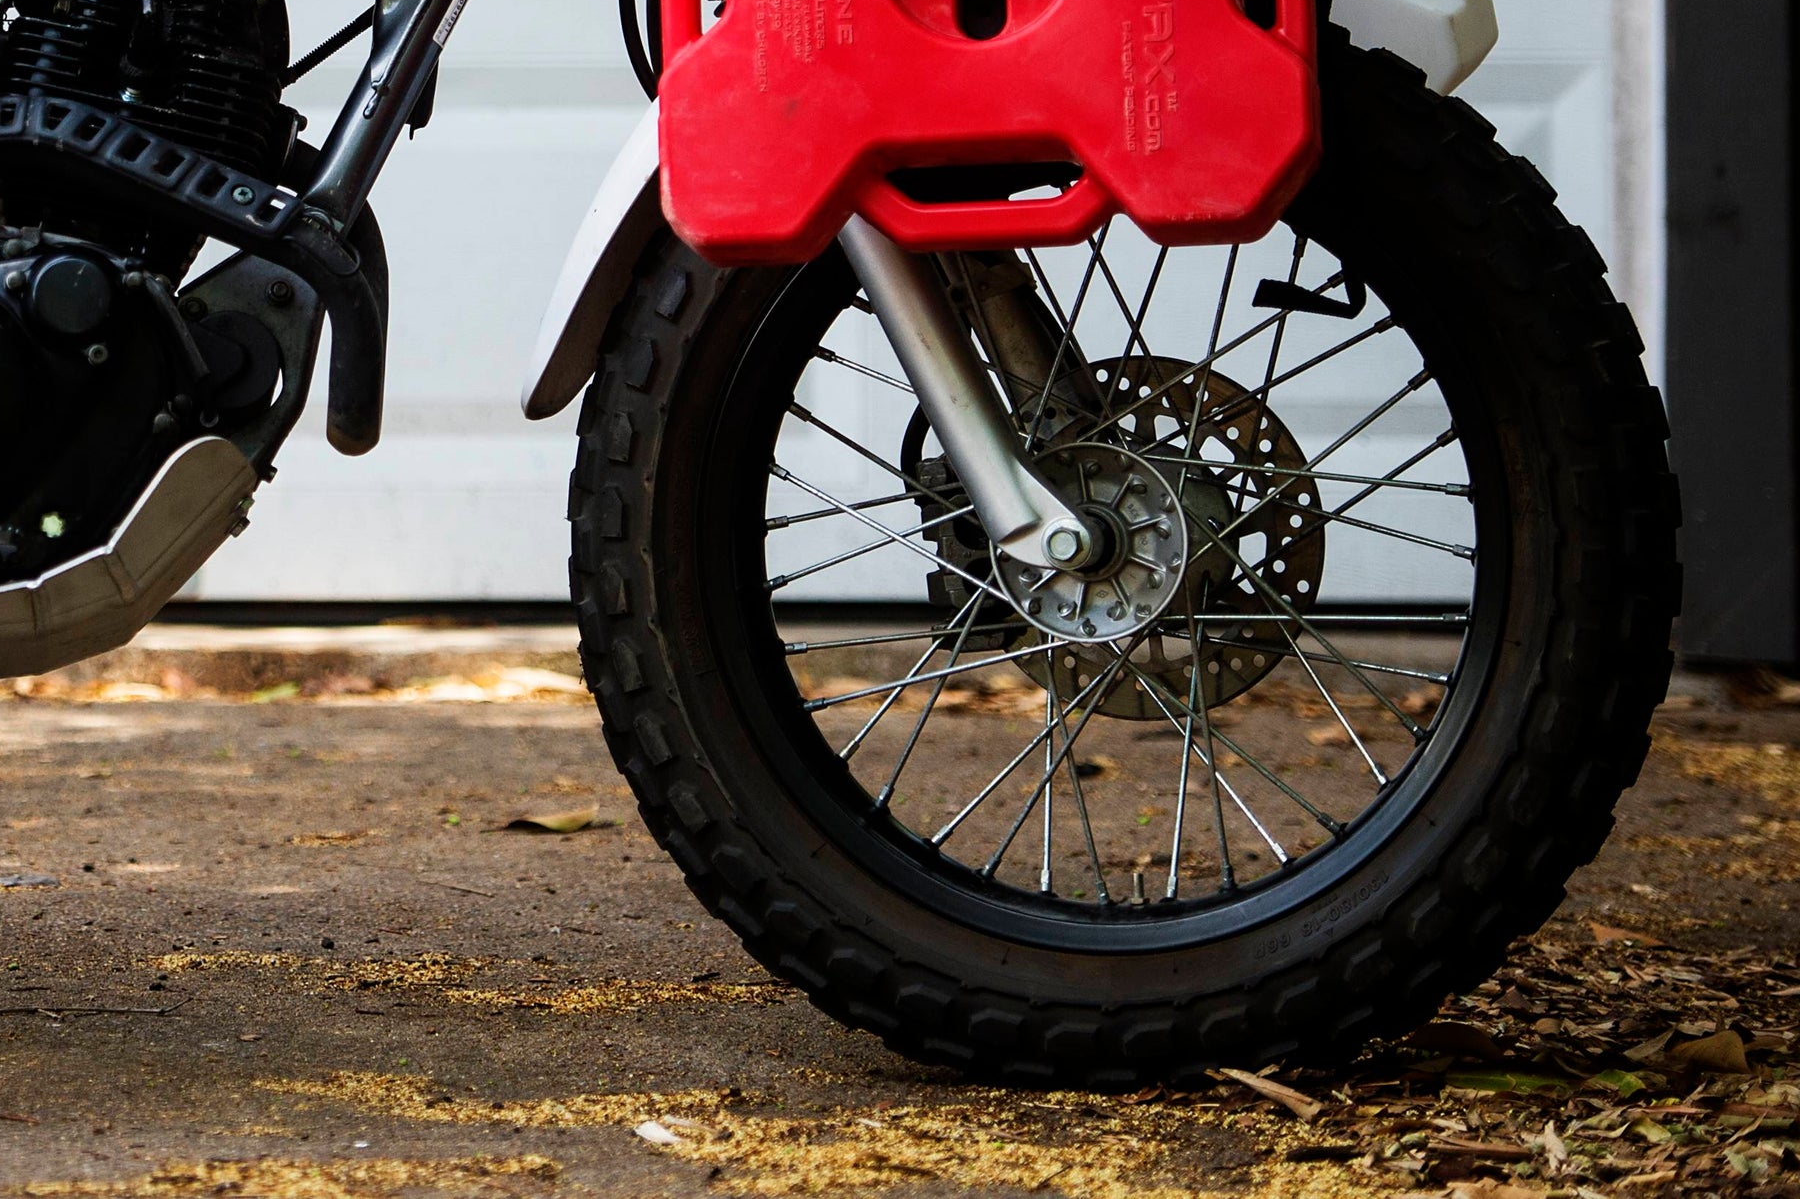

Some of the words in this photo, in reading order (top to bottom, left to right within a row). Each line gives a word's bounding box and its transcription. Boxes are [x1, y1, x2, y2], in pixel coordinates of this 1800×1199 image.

[756, 11, 765, 26] BY
[756, 30, 768, 92] CHILDREN
[1122, 20, 1134, 82] PATENT
[1124, 86, 1136, 152] PENDING
